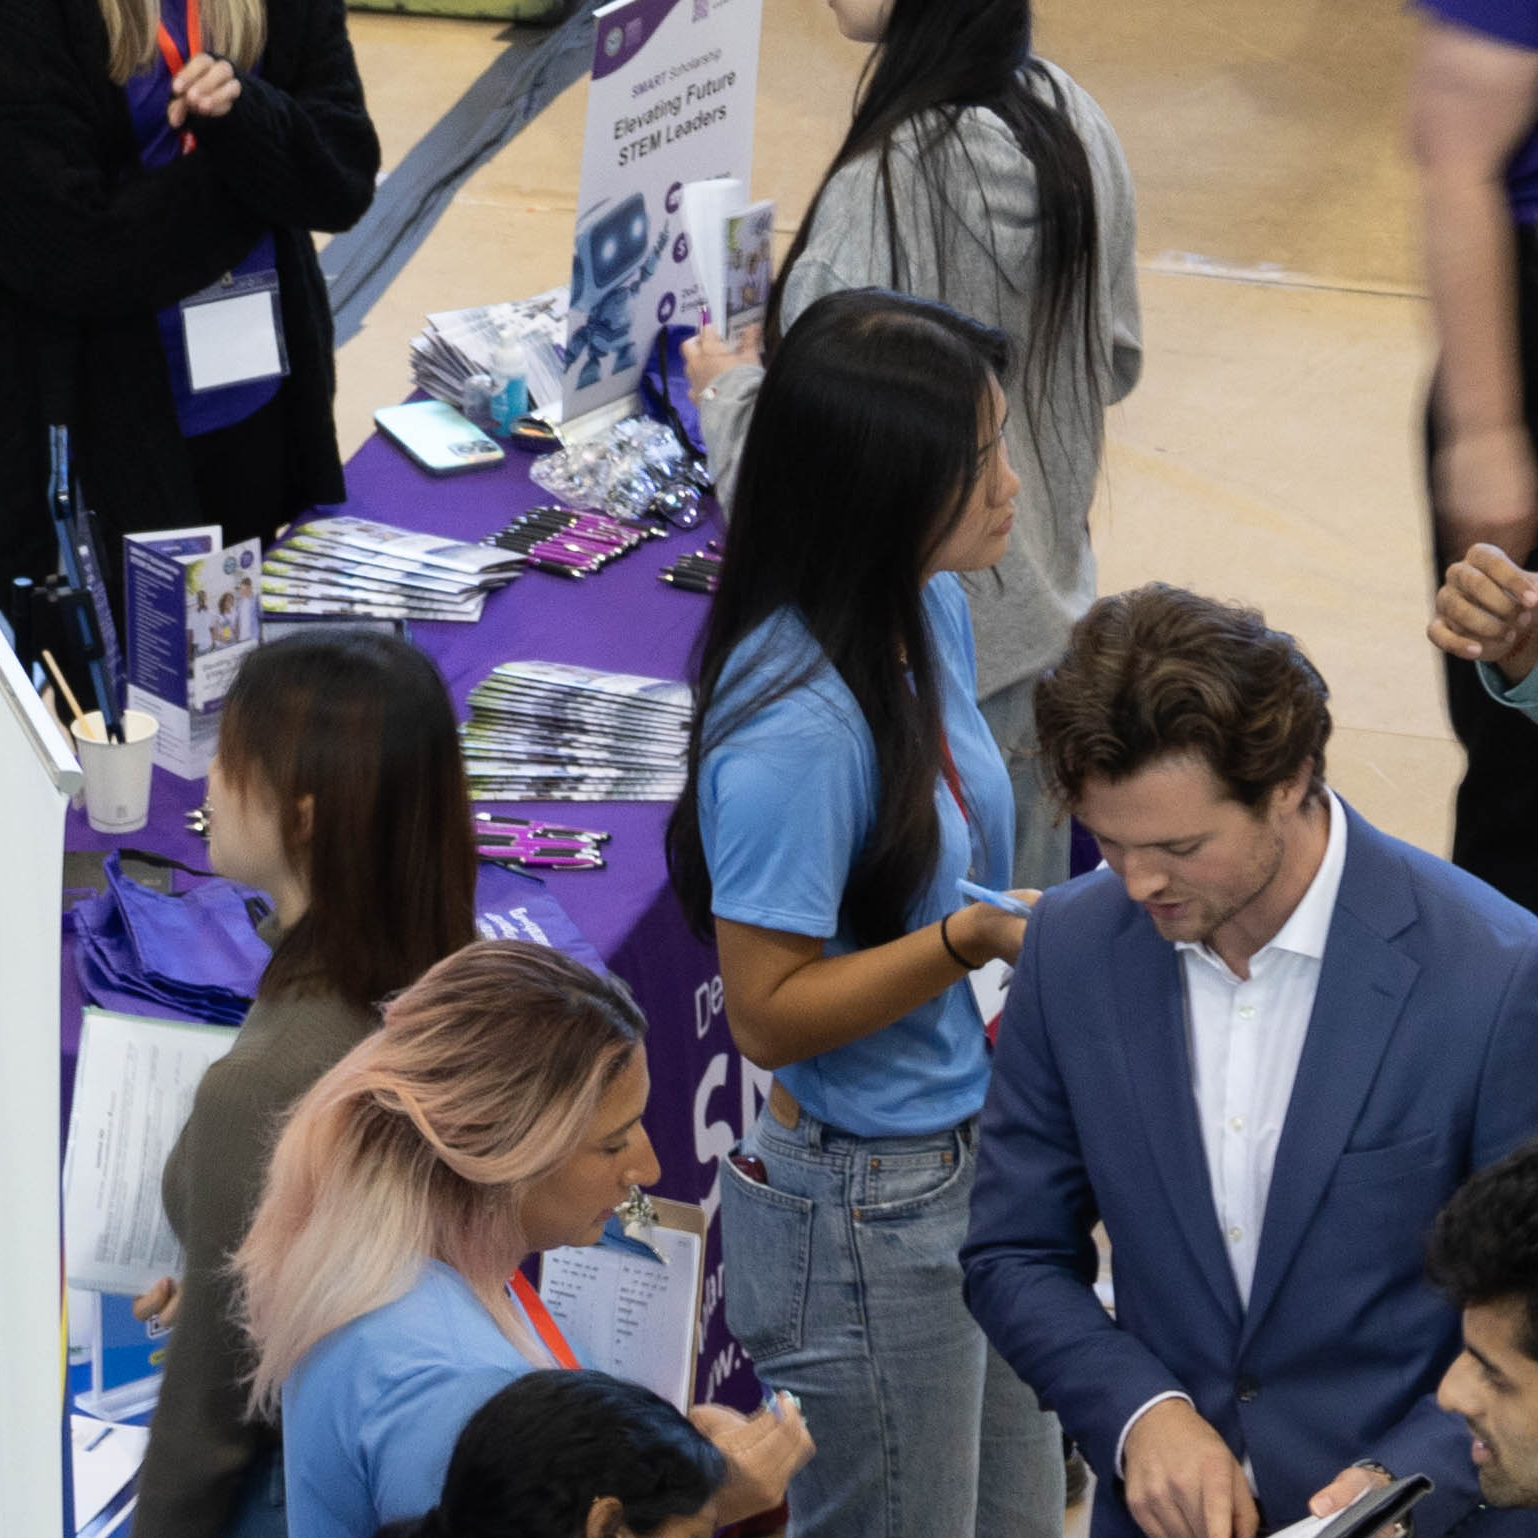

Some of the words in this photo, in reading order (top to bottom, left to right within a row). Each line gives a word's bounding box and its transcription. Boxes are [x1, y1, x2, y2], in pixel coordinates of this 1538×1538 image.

[614, 96, 682, 140] Elevating
[686, 71, 736, 105] Future
[632, 71, 667, 99] SMART
[619, 130, 661, 167] STEM
[666, 105, 727, 144] Leaders
